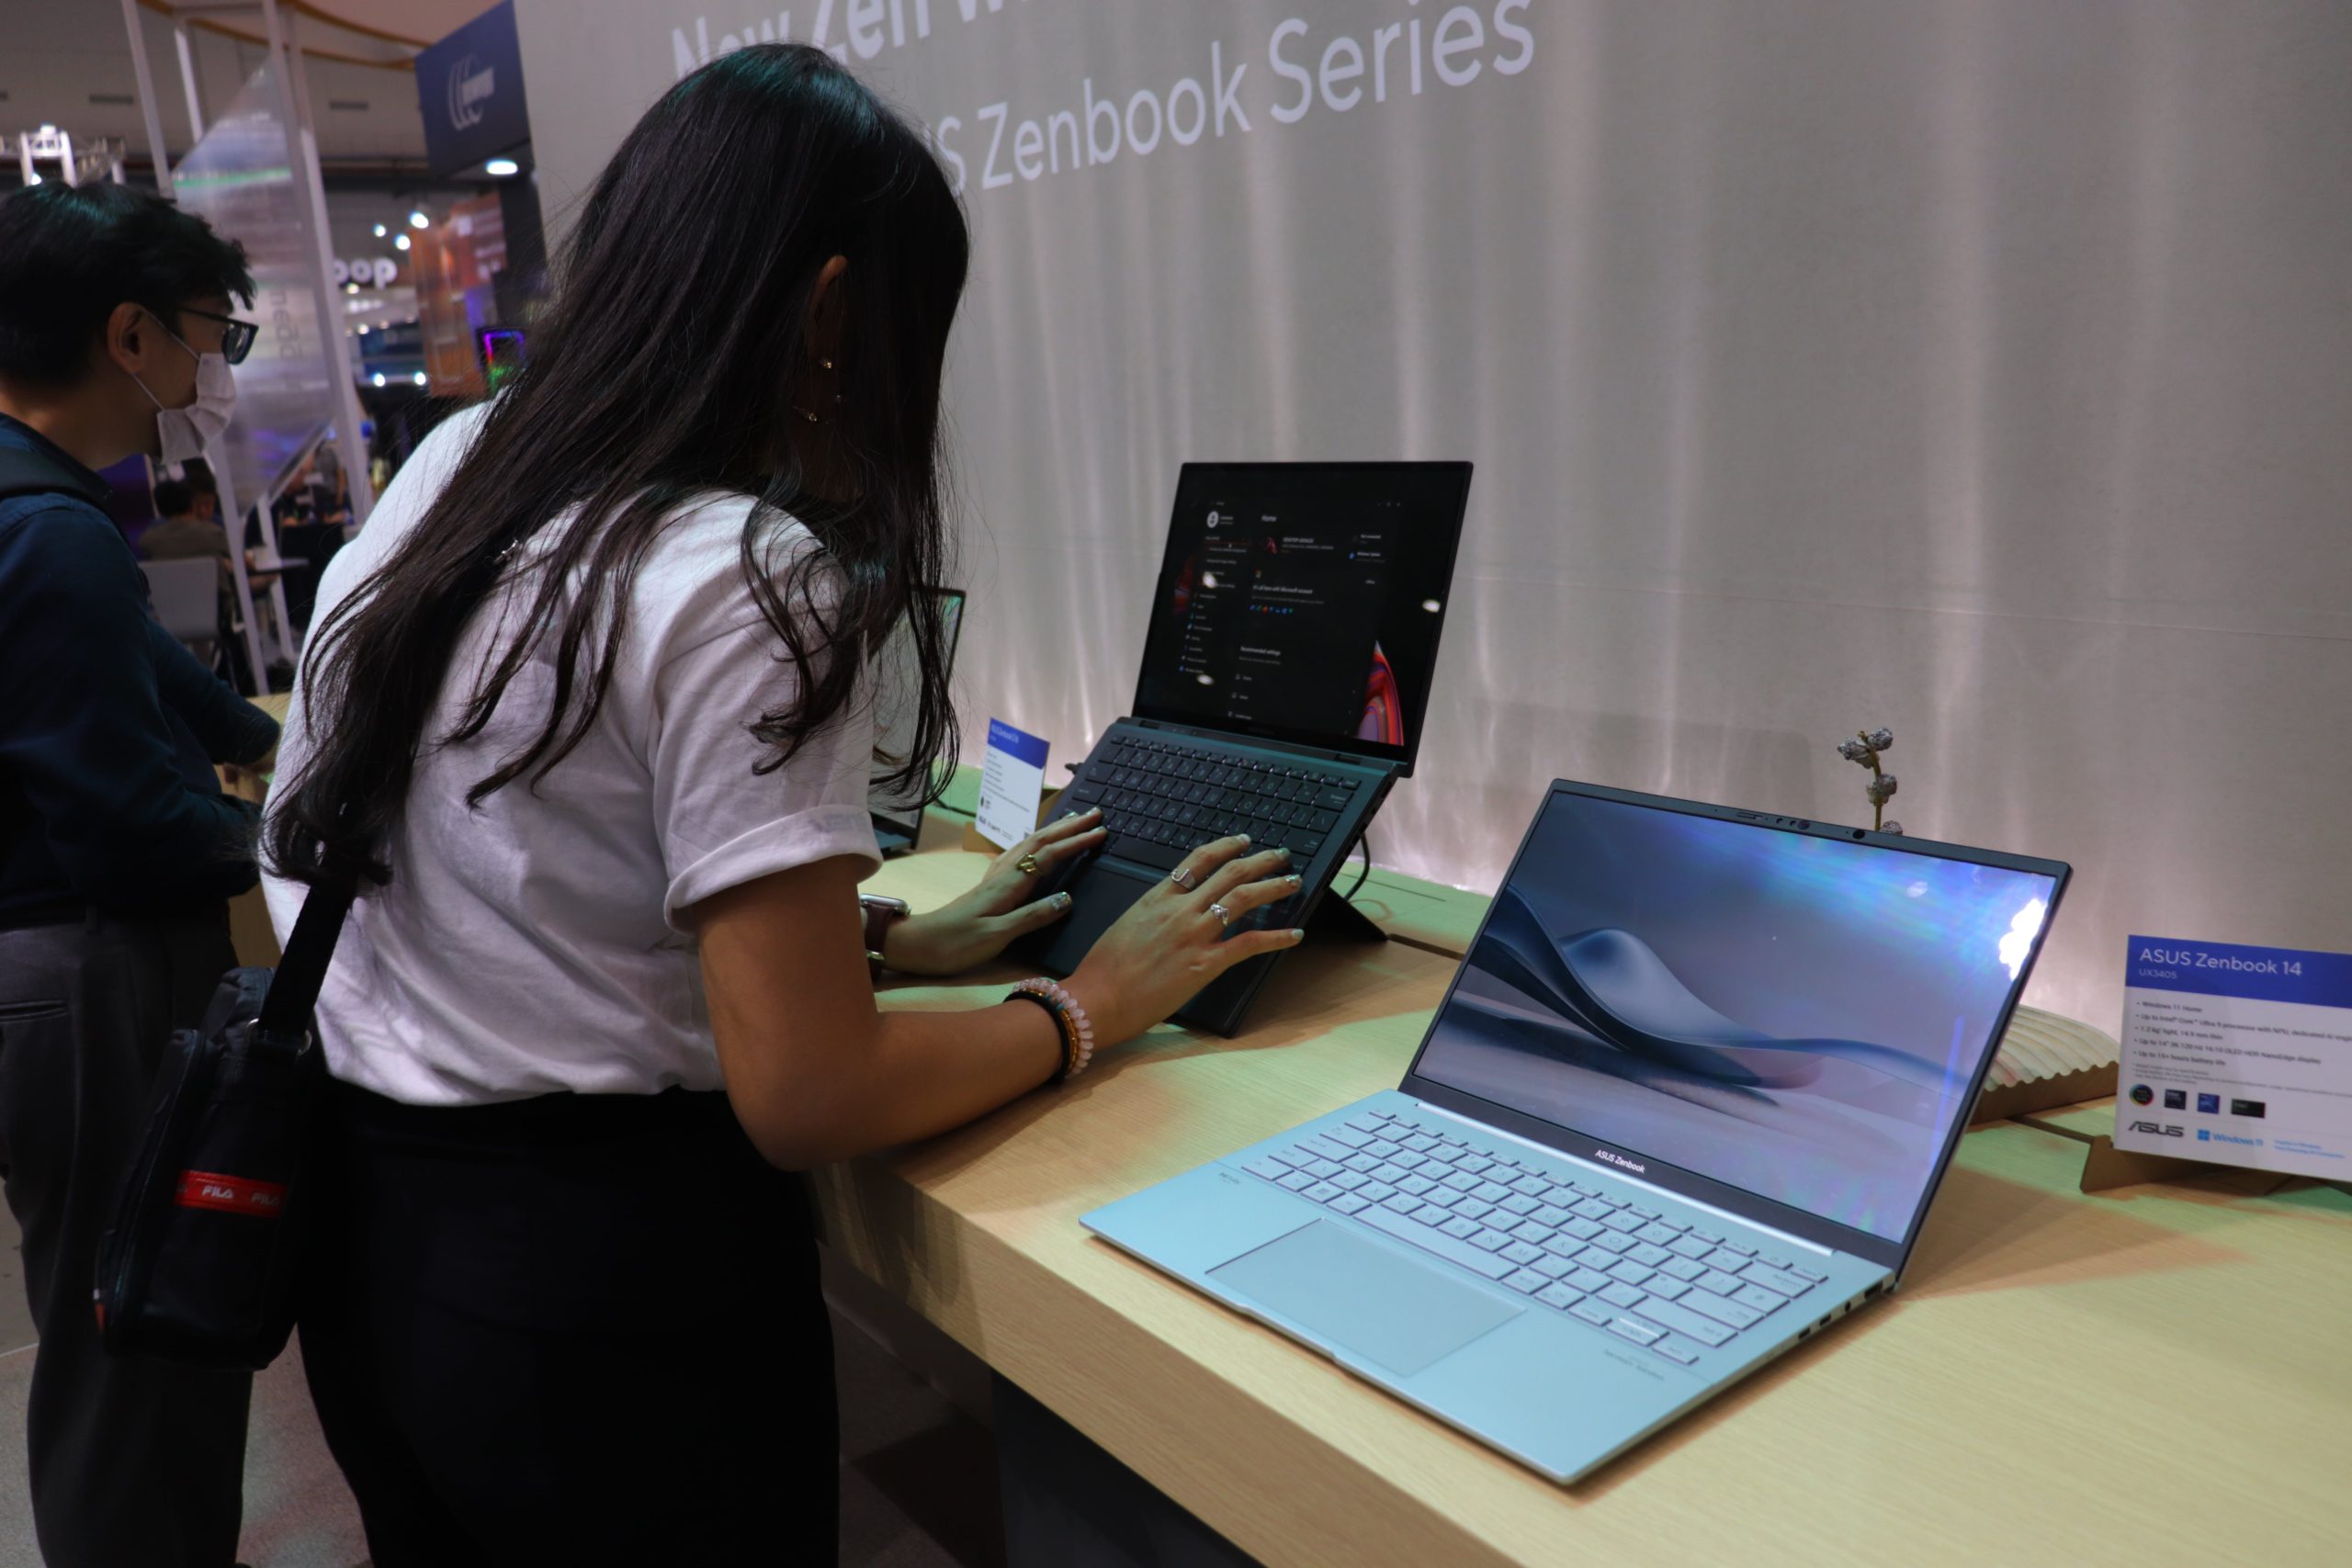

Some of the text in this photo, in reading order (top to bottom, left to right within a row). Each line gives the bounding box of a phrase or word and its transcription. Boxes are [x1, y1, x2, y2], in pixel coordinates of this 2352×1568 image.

[978, 39, 1252, 190] Zenbook
[1269, 0, 1535, 125] Series
[2139, 948, 2303, 976] ASUS Zenbook 14
[2139, 968, 2177, 980] UX3405
[2128, 1121, 2185, 1138] ASUS
[2212, 1133, 2255, 1145] Windows
[1594, 1149, 1645, 1174] ASUS Zenbook
[201, 1185, 234, 1200] FILA
[251, 1191, 280, 1206] FILA
